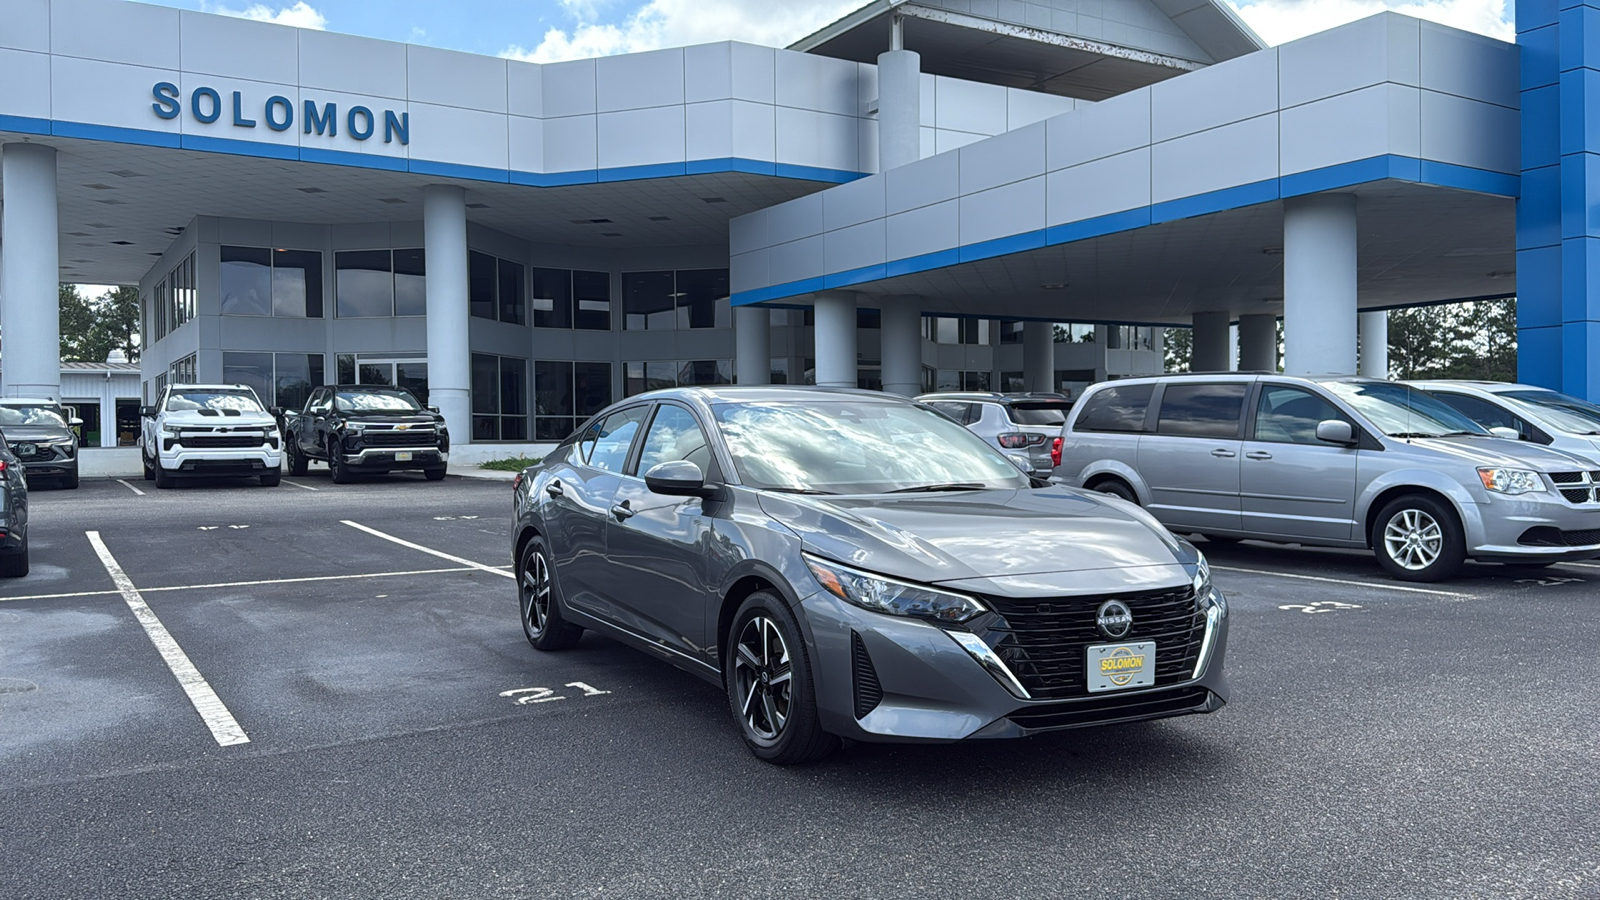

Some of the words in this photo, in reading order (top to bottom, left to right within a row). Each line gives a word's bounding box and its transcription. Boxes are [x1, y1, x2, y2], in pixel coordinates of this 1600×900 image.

[152, 82, 409, 145] SOLOMON
[1097, 613, 1132, 625] NISSAN
[1101, 657, 1143, 671] SOLOMON
[499, 681, 612, 705] 21
